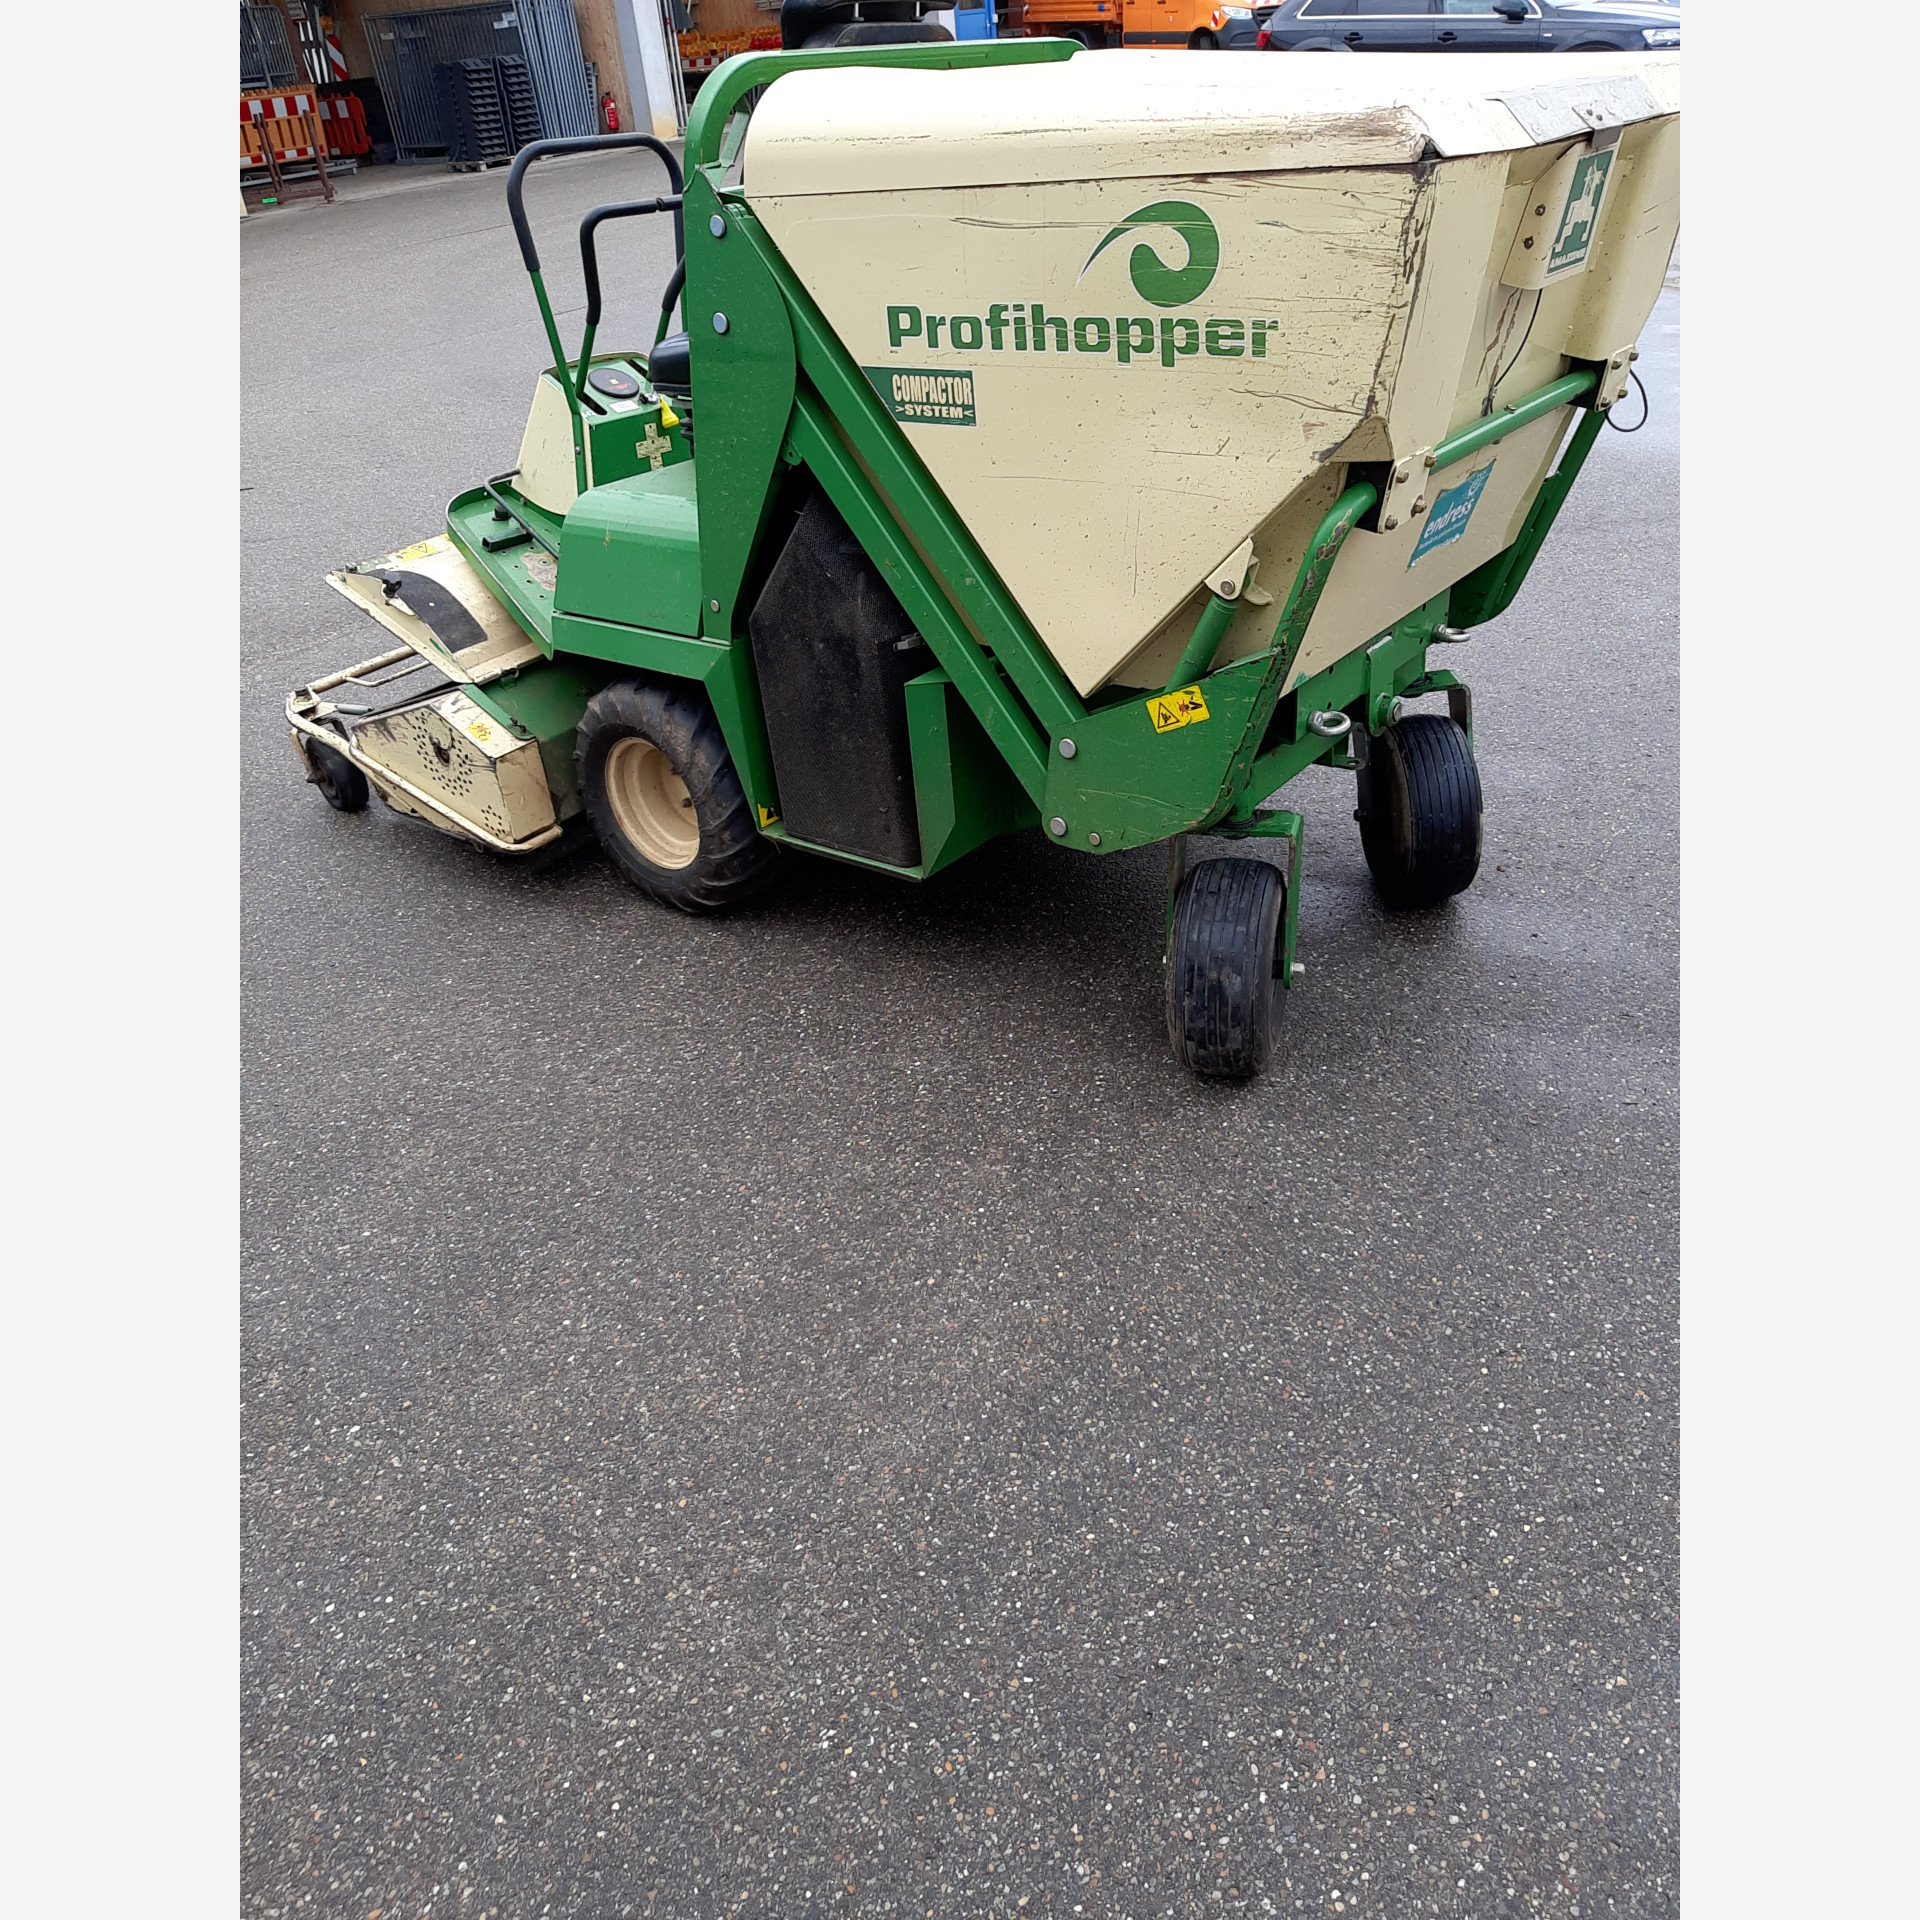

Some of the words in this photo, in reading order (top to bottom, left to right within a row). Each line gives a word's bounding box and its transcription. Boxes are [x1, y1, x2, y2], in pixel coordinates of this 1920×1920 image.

[887, 303, 1279, 367] Profihopper
[892, 373, 973, 405] COMPACTOR
[1424, 499, 1475, 539] endress
